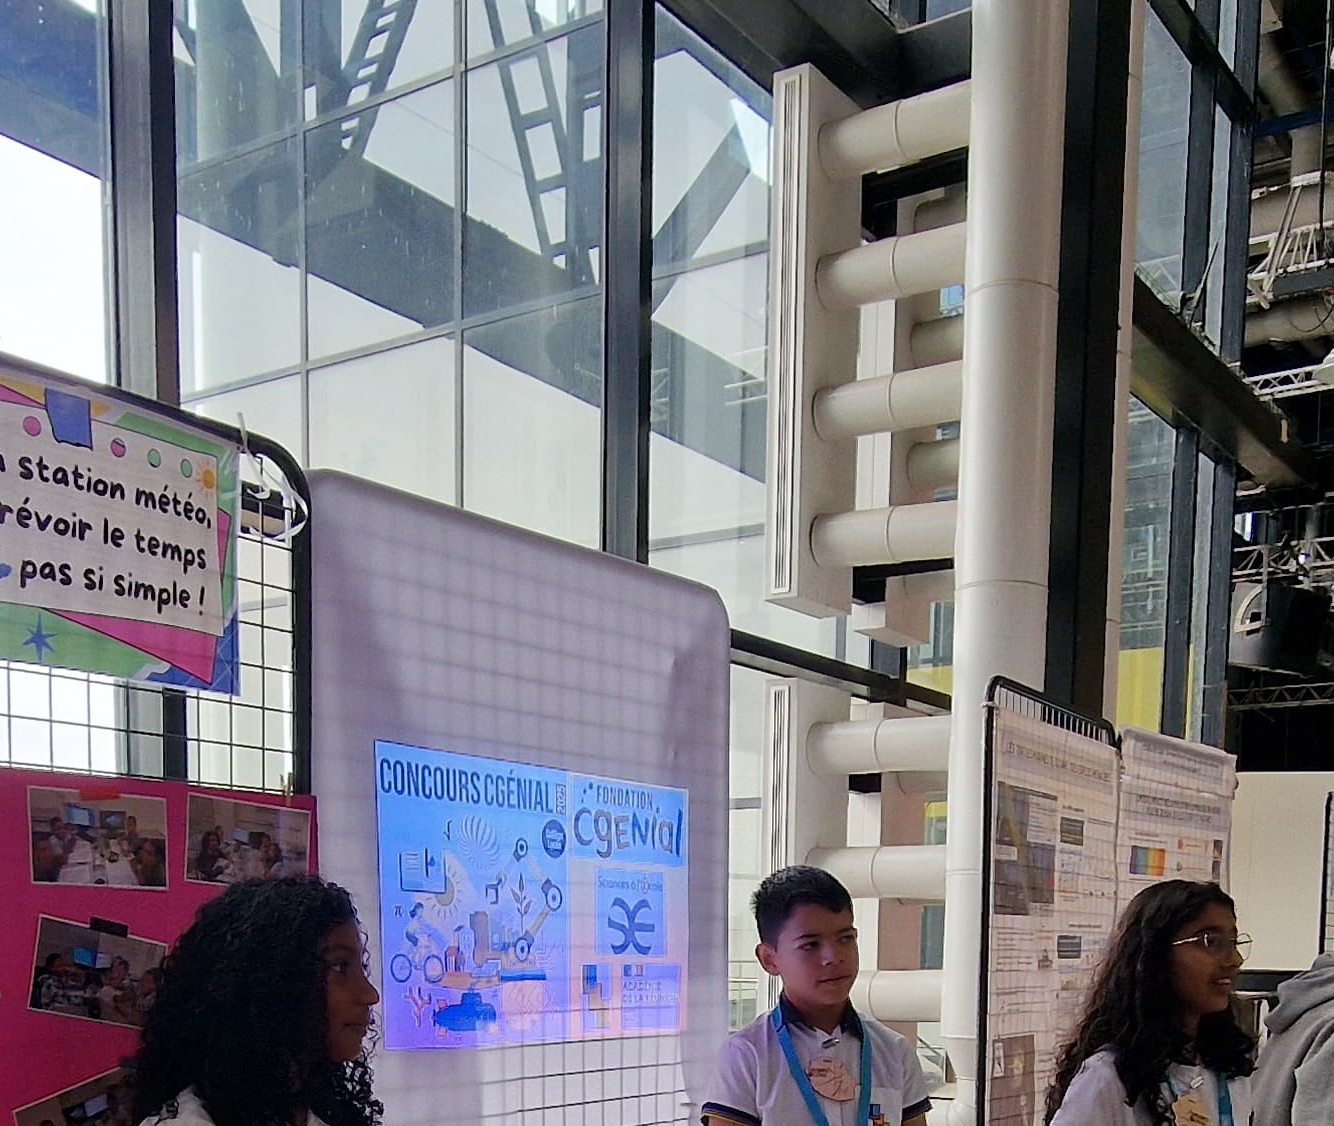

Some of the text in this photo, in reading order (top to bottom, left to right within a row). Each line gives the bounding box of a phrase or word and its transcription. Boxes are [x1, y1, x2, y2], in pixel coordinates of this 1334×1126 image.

[17, 455, 126, 502] station
[134, 484, 213, 530] météo,
[103, 517, 126, 549] le
[134, 528, 208, 575] temps
[19, 558, 206, 616] pas si simple !
[379, 757, 482, 806] CONCOURS
[483, 768, 554, 815] CGÉNIAL
[597, 785, 653, 810] FONDATION
